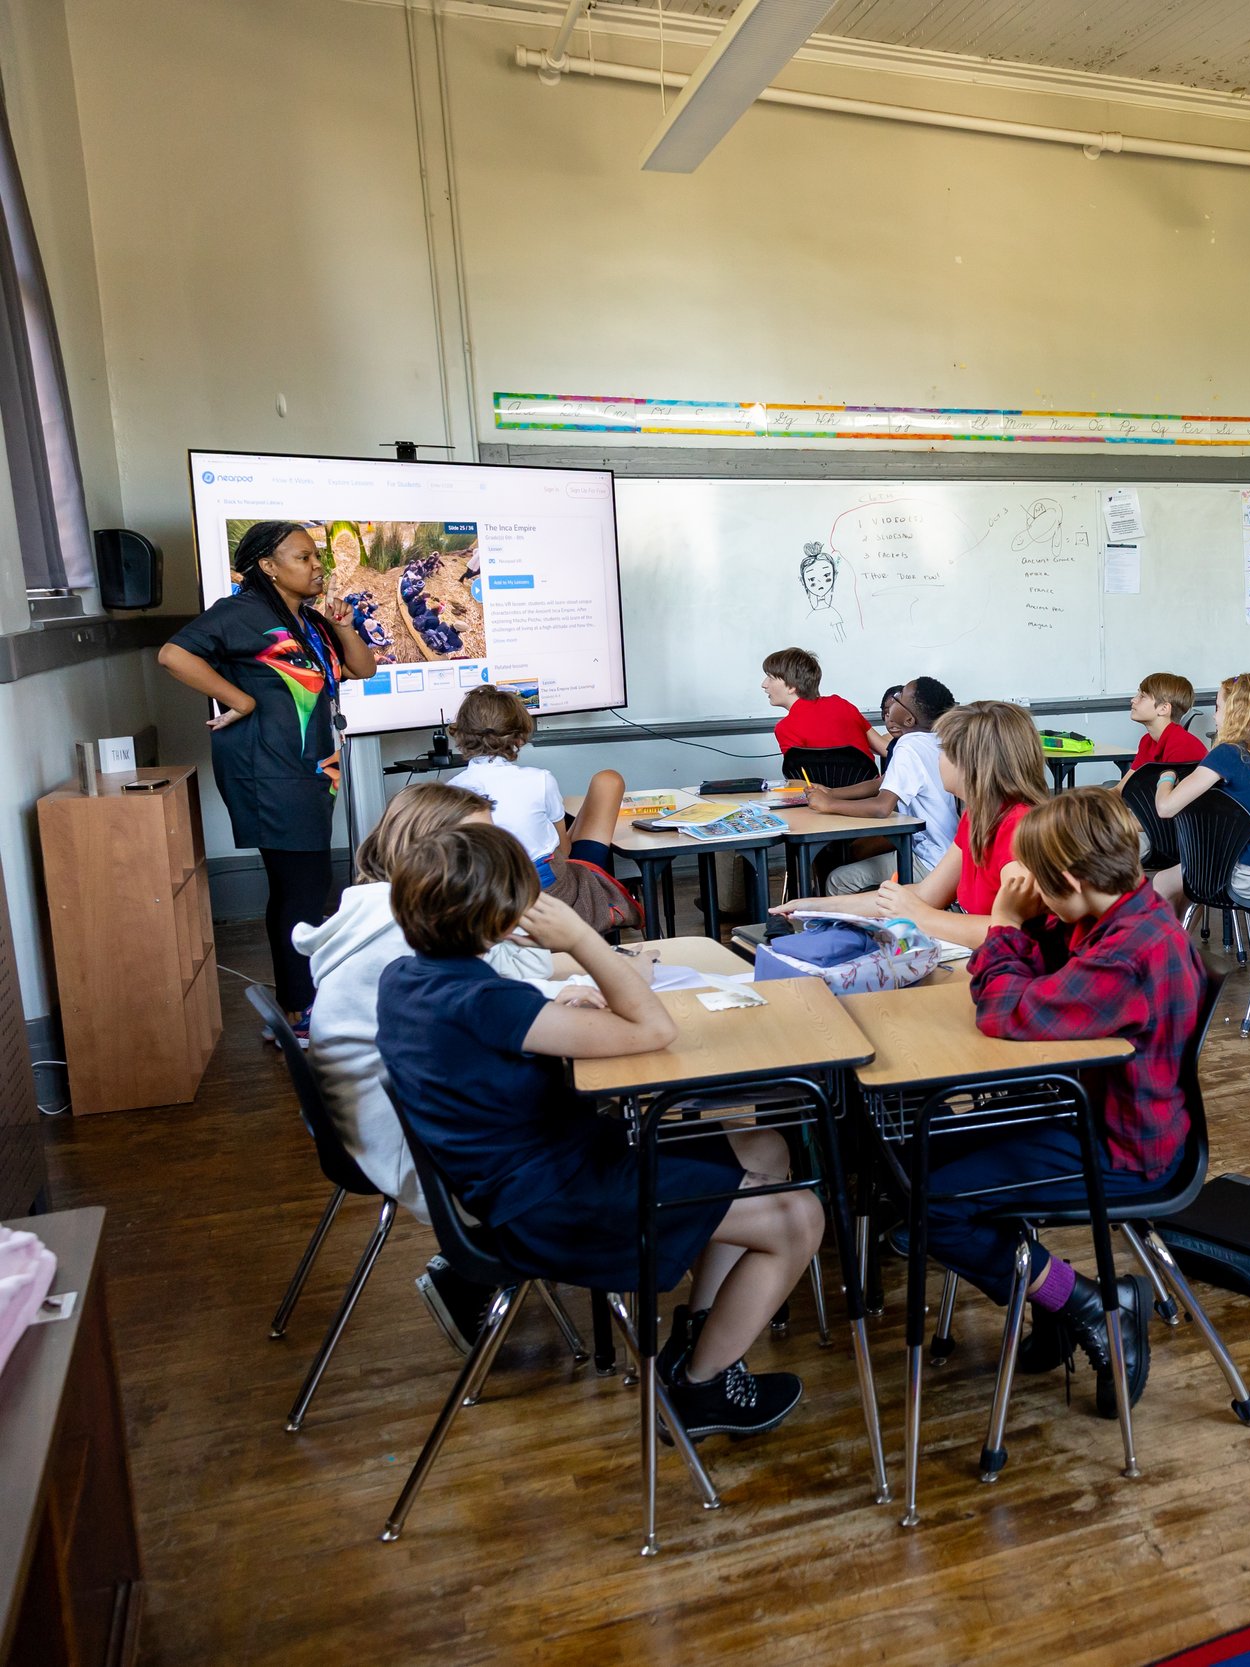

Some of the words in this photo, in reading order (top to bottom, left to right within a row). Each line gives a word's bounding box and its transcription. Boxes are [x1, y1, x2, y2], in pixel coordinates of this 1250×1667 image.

[217, 474, 254, 484] nearpod
[514, 524, 537, 533] Empire
[111, 750, 130, 760] THINK
